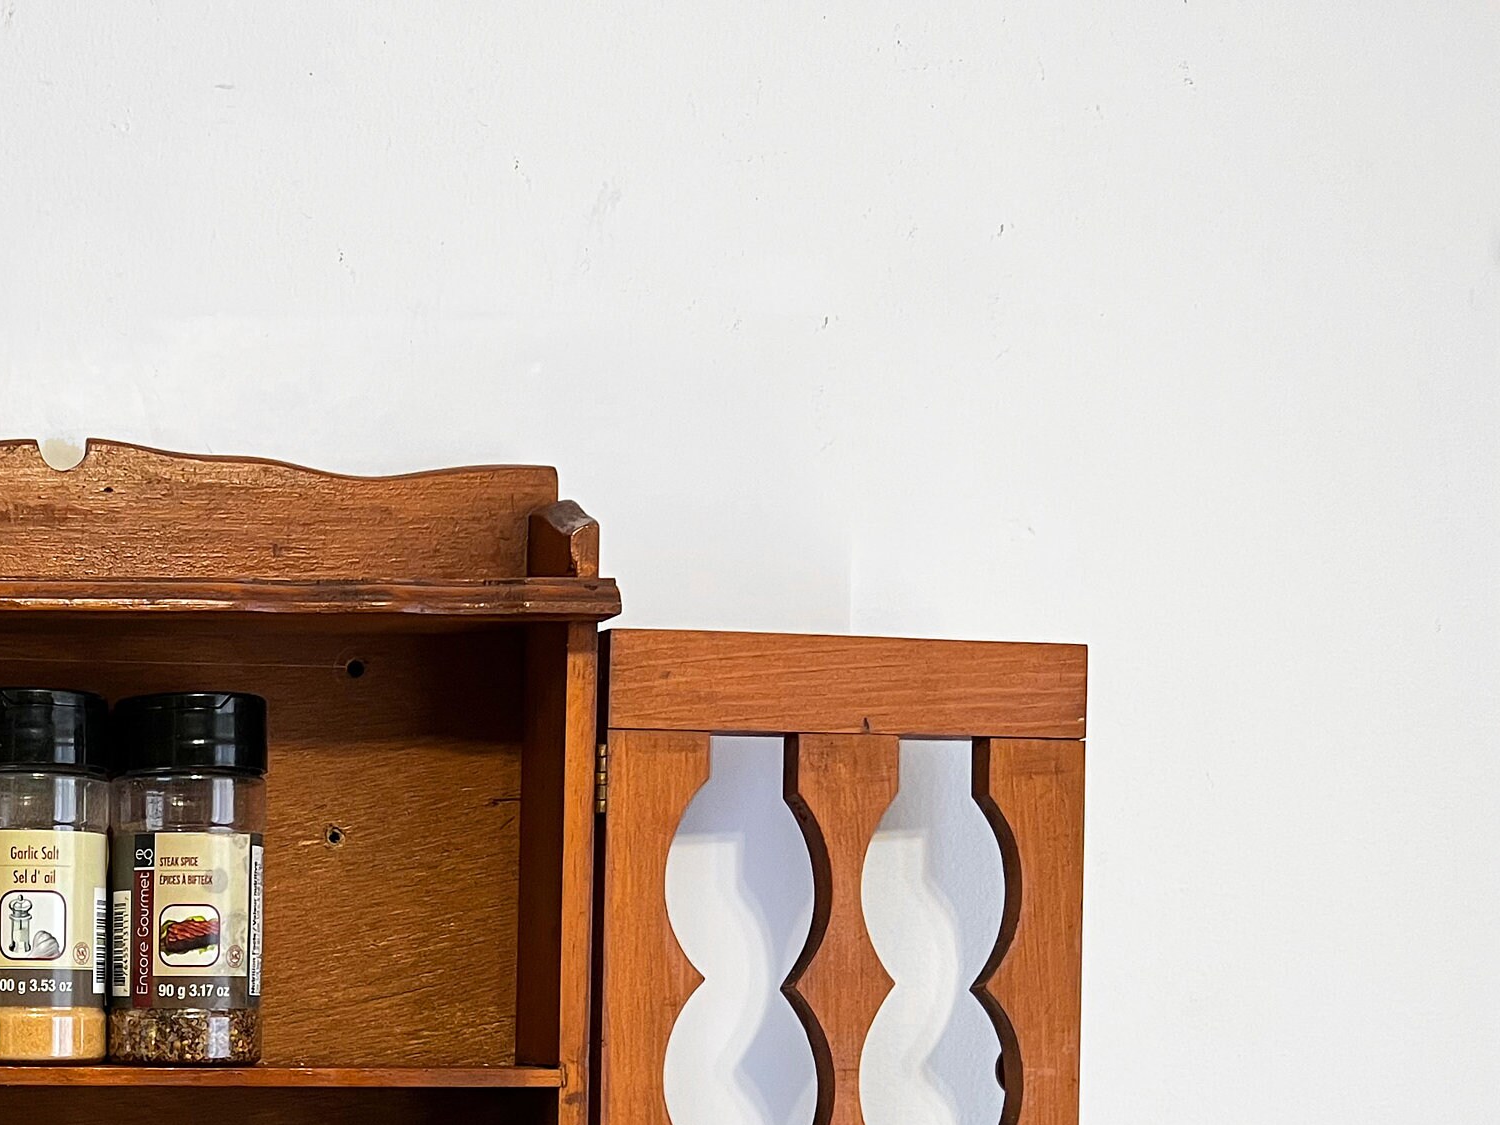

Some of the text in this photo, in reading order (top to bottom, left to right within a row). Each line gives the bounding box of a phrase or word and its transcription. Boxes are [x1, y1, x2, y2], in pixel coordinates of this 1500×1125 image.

[10, 845, 59, 860] Garlic Salt
[160, 857, 198, 867] STEAK SPICE
[13, 869, 27, 884] Sel
[187, 875, 213, 885] BIFTECK
[137, 872, 150, 995] Encore Gourmet
[18, 981, 26, 994] g
[30, 979, 56, 992] 3.53
[60, 981, 72, 992] oz
[158, 984, 229, 999] 90 g 3.17 oz
